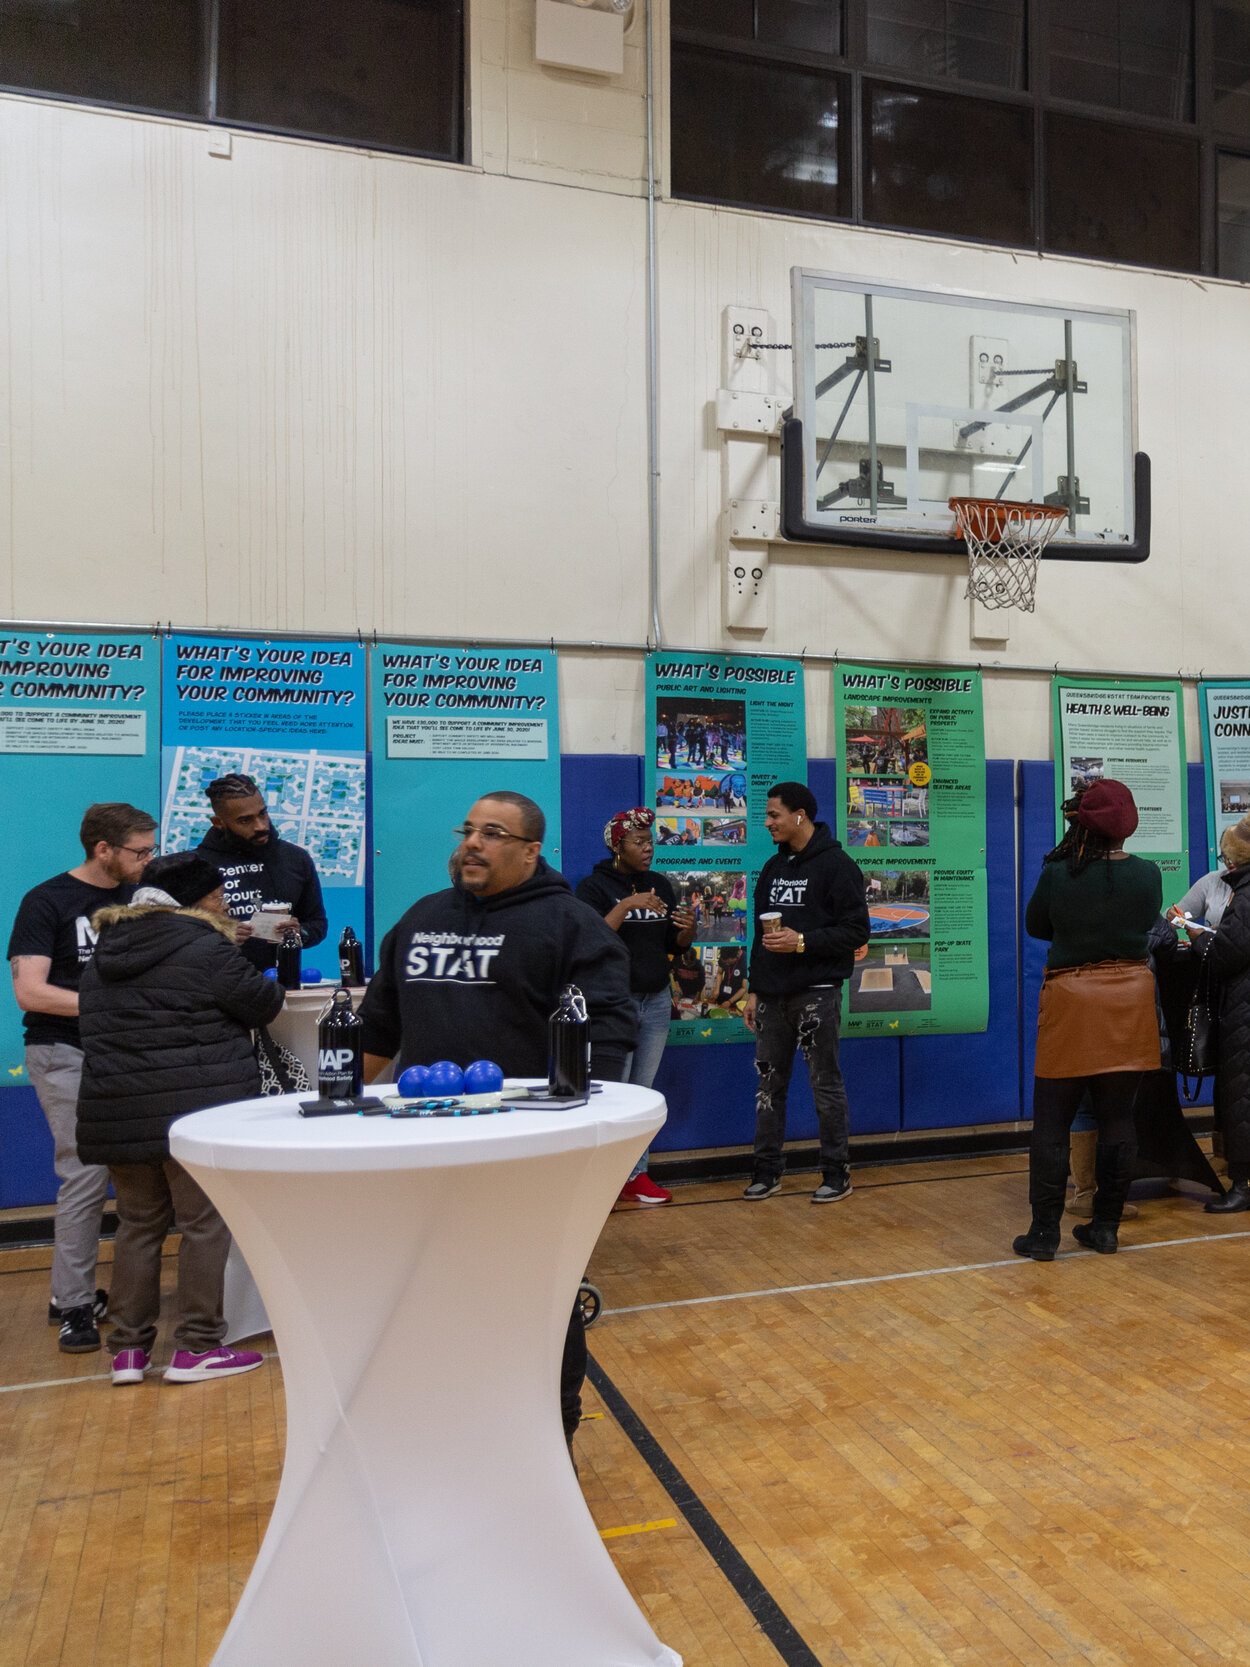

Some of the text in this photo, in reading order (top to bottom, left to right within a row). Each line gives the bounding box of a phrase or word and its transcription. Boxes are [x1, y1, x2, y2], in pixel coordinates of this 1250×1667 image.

[37, 641, 91, 658] YOUR
[97, 643, 143, 660] IDEA
[176, 645, 352, 667] WHAT'S YOUR IDEA
[0, 661, 110, 678] IMPROVING
[383, 654, 543, 673] WHAT'S YOUR IDEA
[176, 665, 324, 685] FOR IMPROVING
[383, 673, 517, 691] FOR IMPROVING
[656, 663, 797, 685] WHAT'S POSSIBLE
[11, 682, 146, 701] COMMUNITY?
[716, 687, 746, 695] LIGHTING
[843, 674, 973, 694] WHAT'S POSSIBLE
[176, 685, 356, 707] YOUR COMMUNITY?
[384, 692, 546, 711] YOUR COMMUNITY?
[844, 693, 932, 704] LANDSCAPE IMPROVEMENTS
[1066, 703, 1170, 717] HEALTH & WELL-BEING
[224, 878, 241, 890] or
[406, 946, 500, 979] STAT
